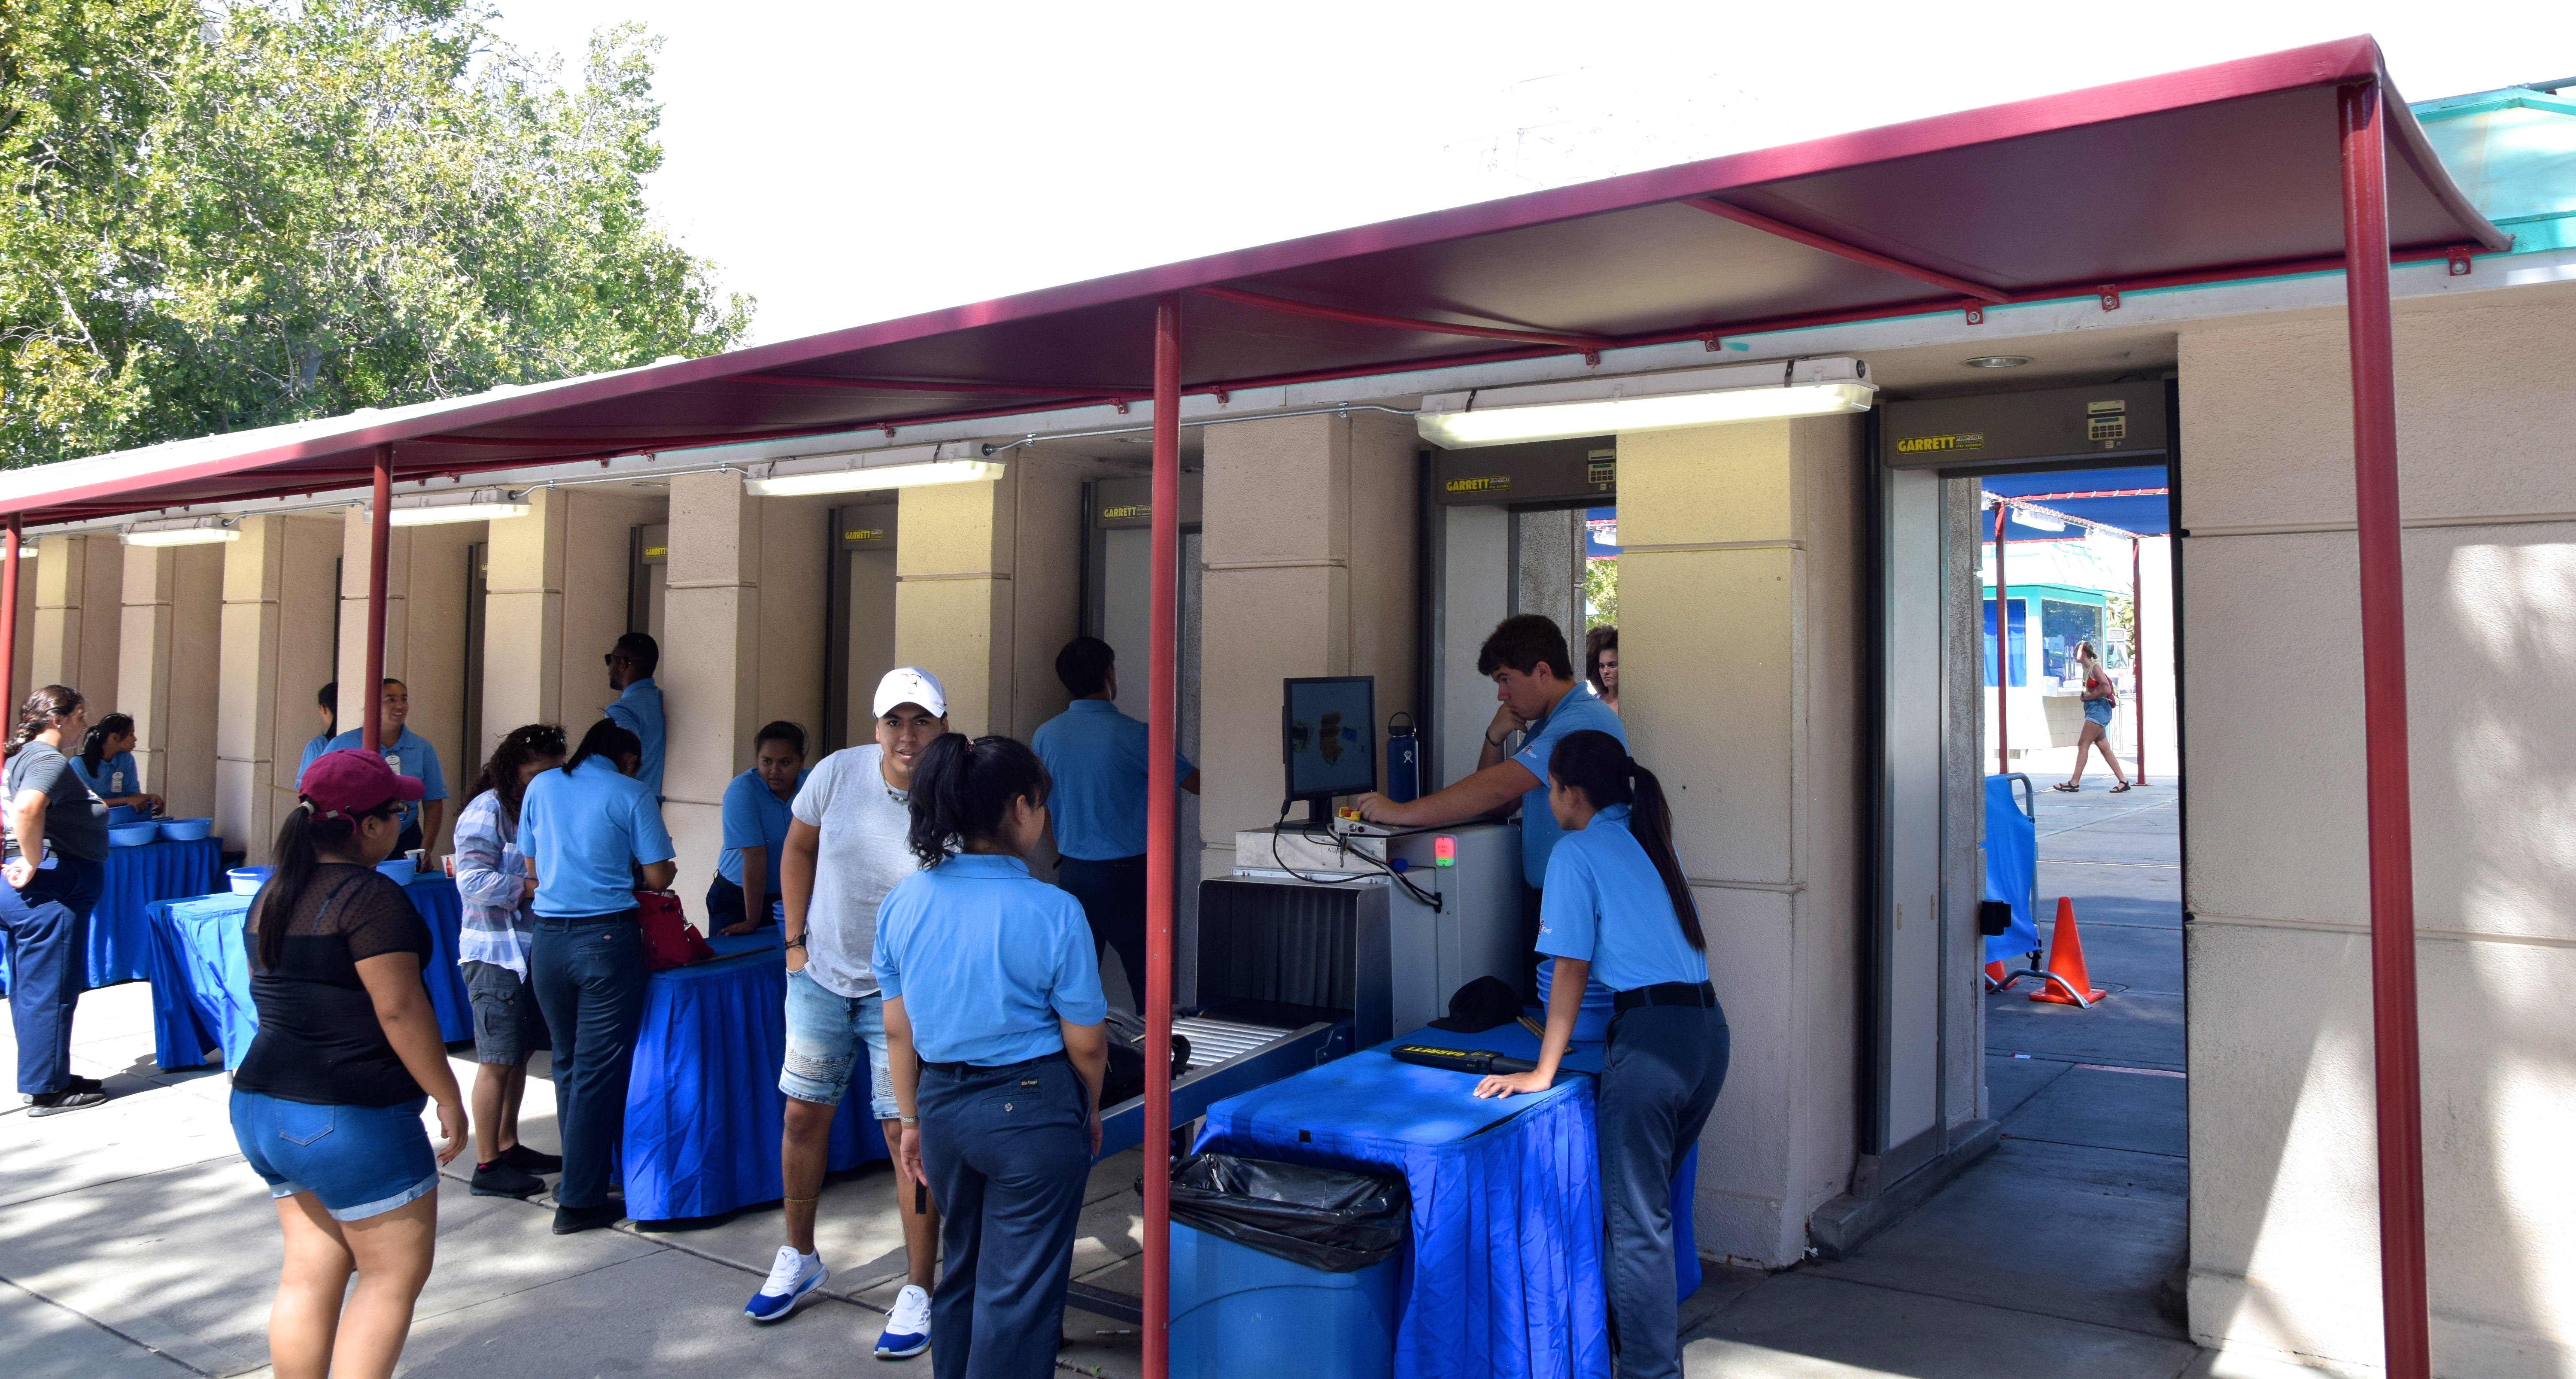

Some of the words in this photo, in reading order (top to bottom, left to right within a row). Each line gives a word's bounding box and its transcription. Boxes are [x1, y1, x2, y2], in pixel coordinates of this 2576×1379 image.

[1898, 436, 1955, 452] GARRETT
[1446, 478, 1489, 491] GARRETT
[1104, 507, 1136, 517] GARRETT
[845, 531, 871, 539] GARRETT
[646, 547, 666, 556] GARRETT
[1403, 1047, 1466, 1057] GARRETT
